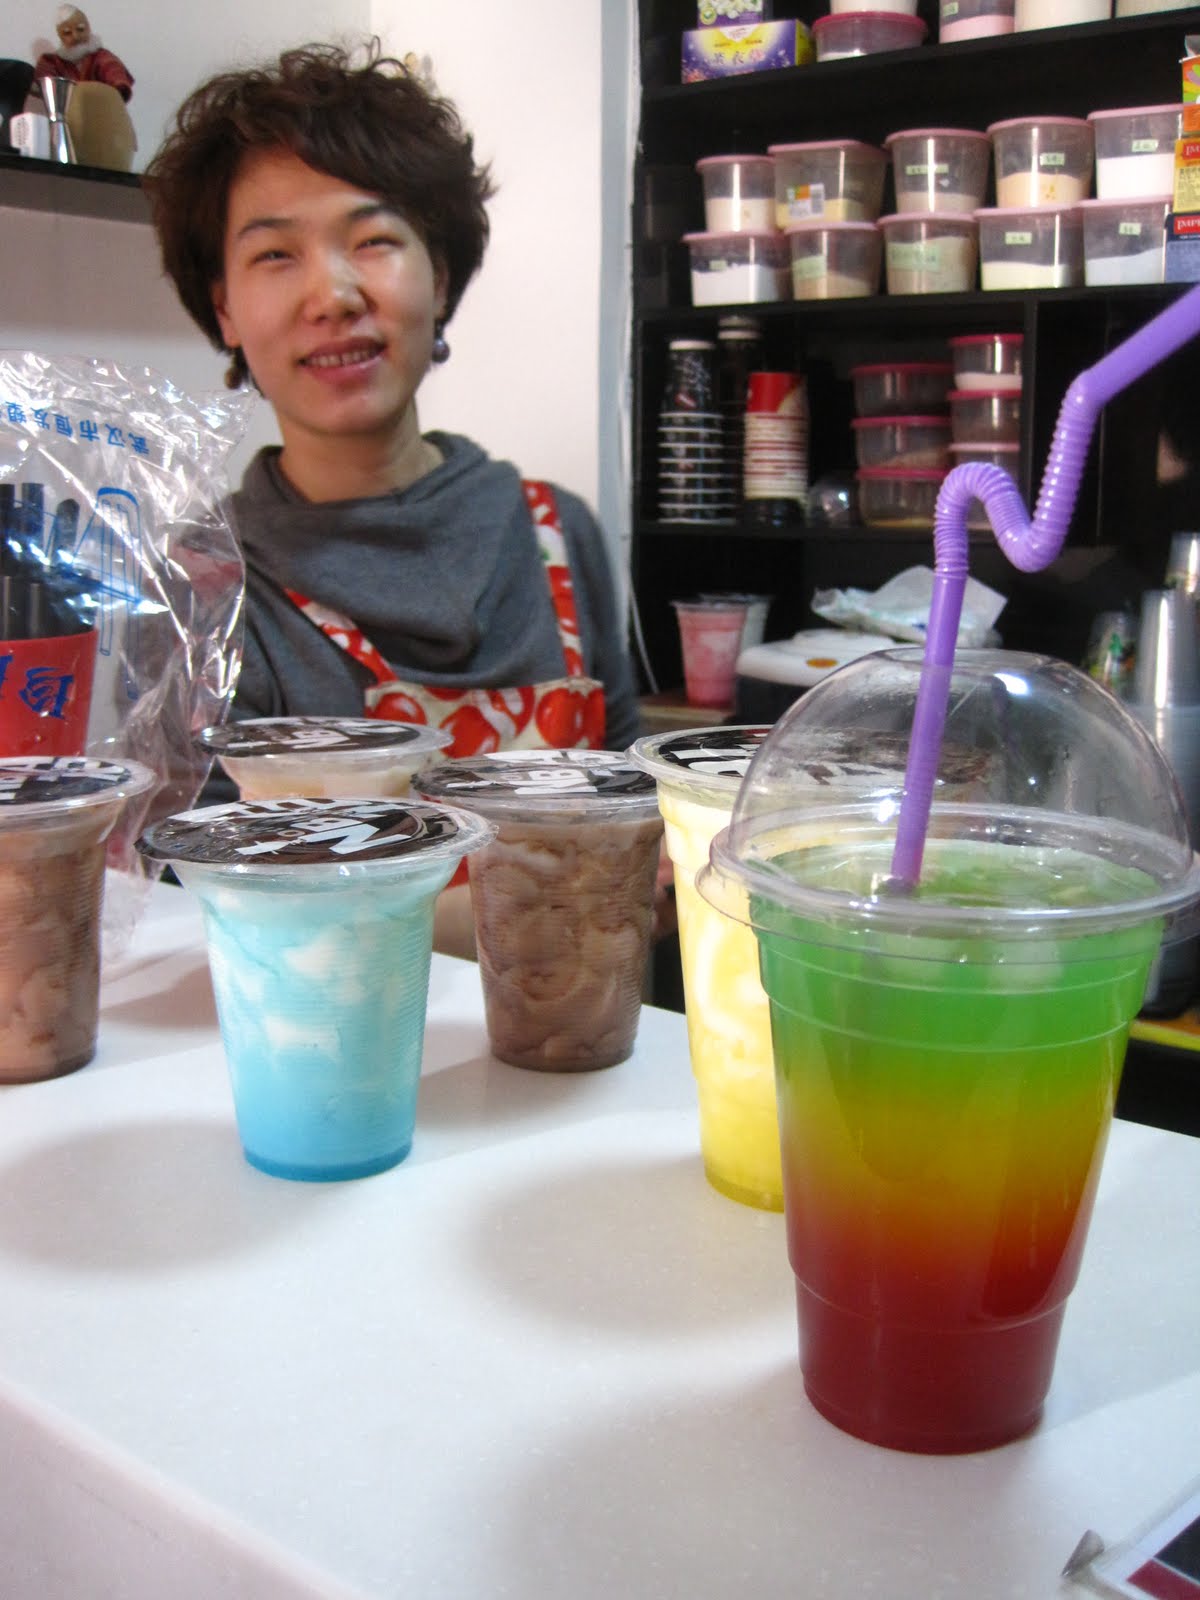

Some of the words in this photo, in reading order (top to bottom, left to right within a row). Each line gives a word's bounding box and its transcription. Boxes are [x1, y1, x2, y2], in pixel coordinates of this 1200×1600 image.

[1177, 219, 1200, 231] IMP
[0, 401, 149, 455] 武汉市恒发塑
